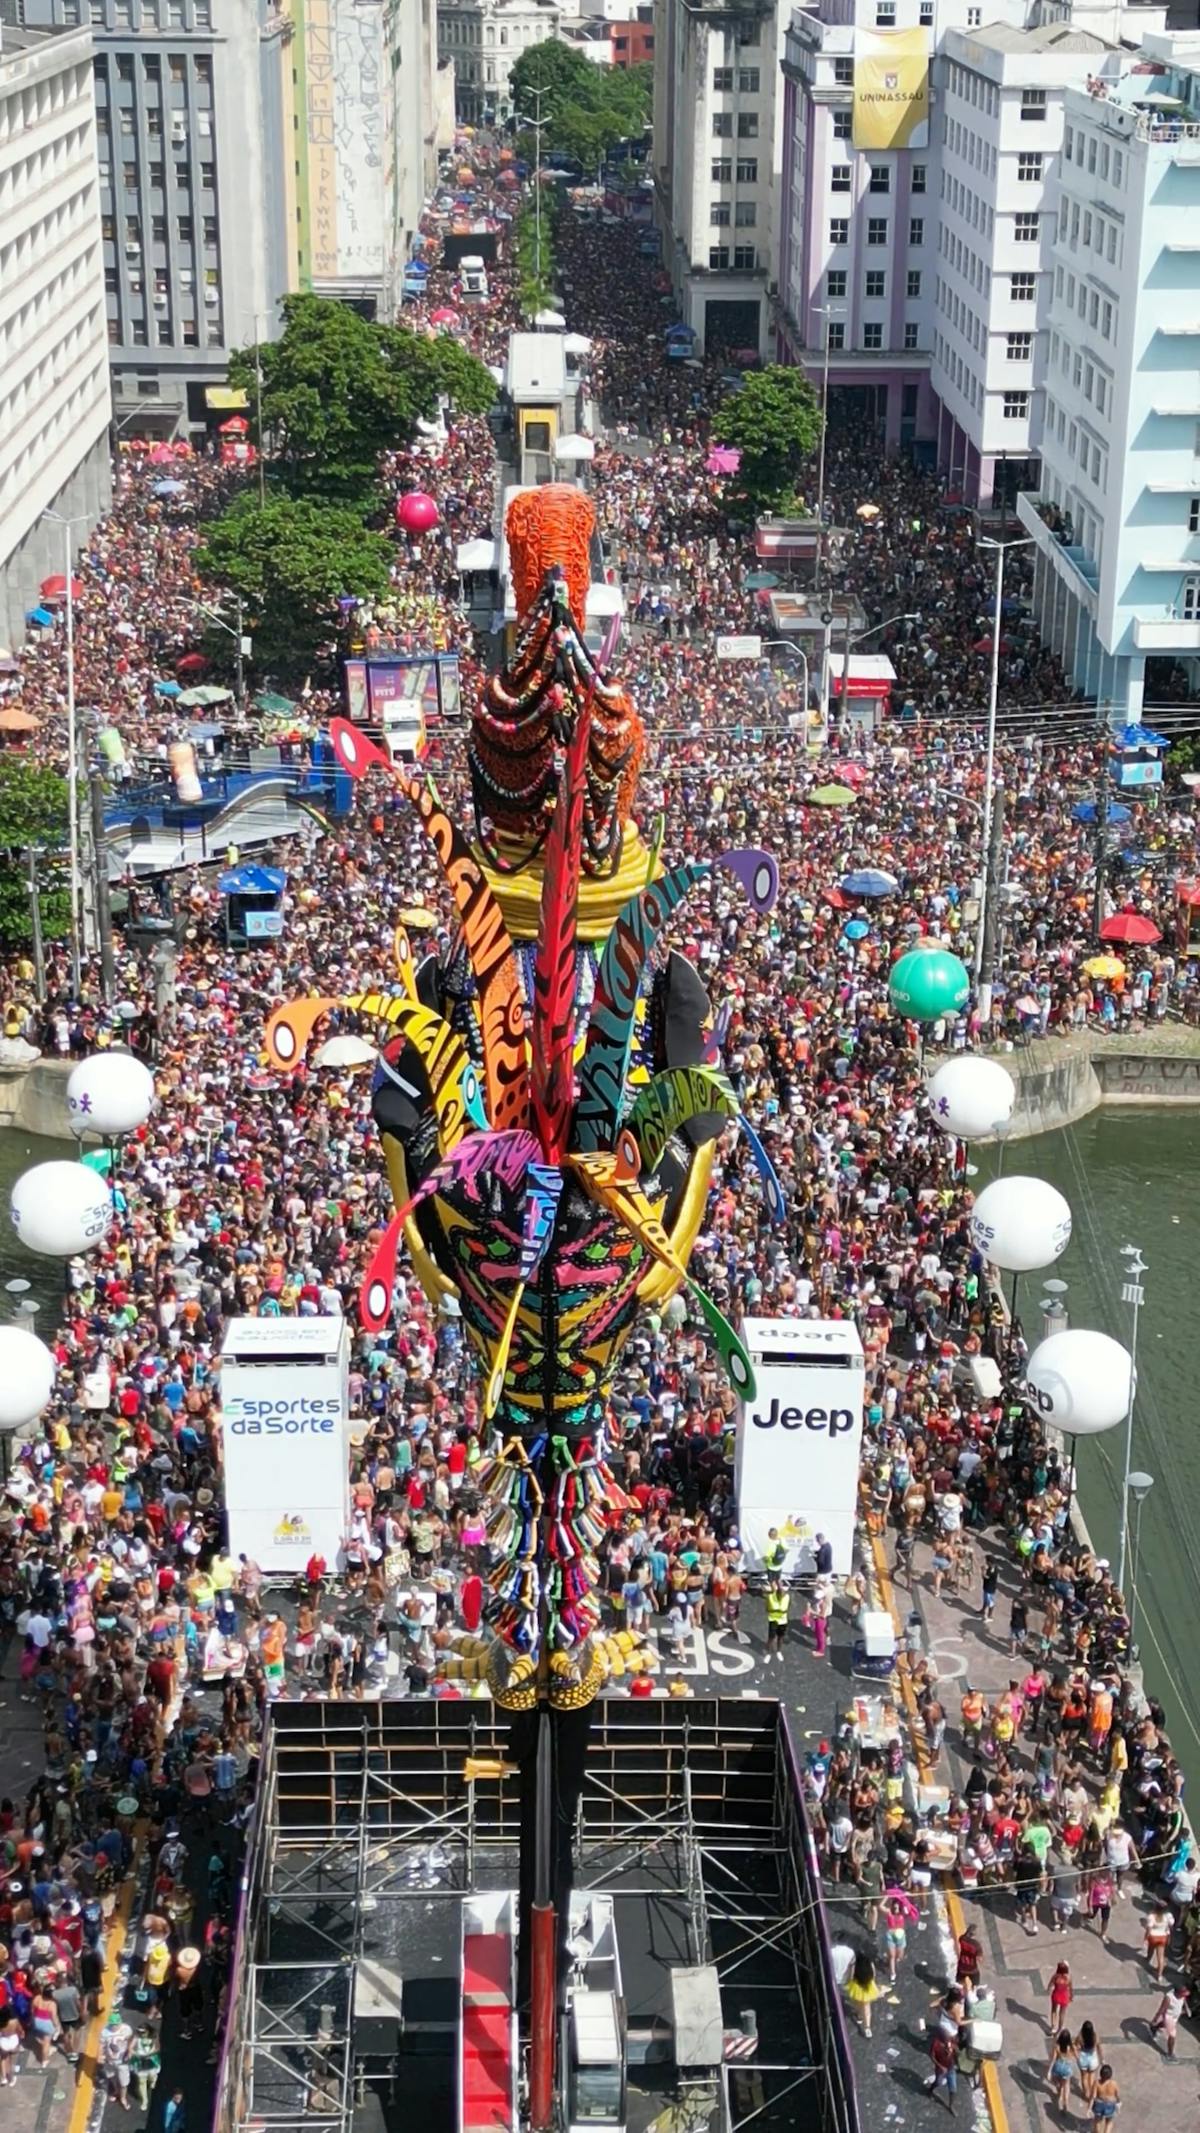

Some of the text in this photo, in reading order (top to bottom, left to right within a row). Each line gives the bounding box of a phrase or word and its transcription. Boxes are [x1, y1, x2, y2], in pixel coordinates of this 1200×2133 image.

[860, 92, 923, 102] UNINASSAU
[224, 1398, 341, 1419] Esportes
[752, 1398, 854, 1438] Jeep
